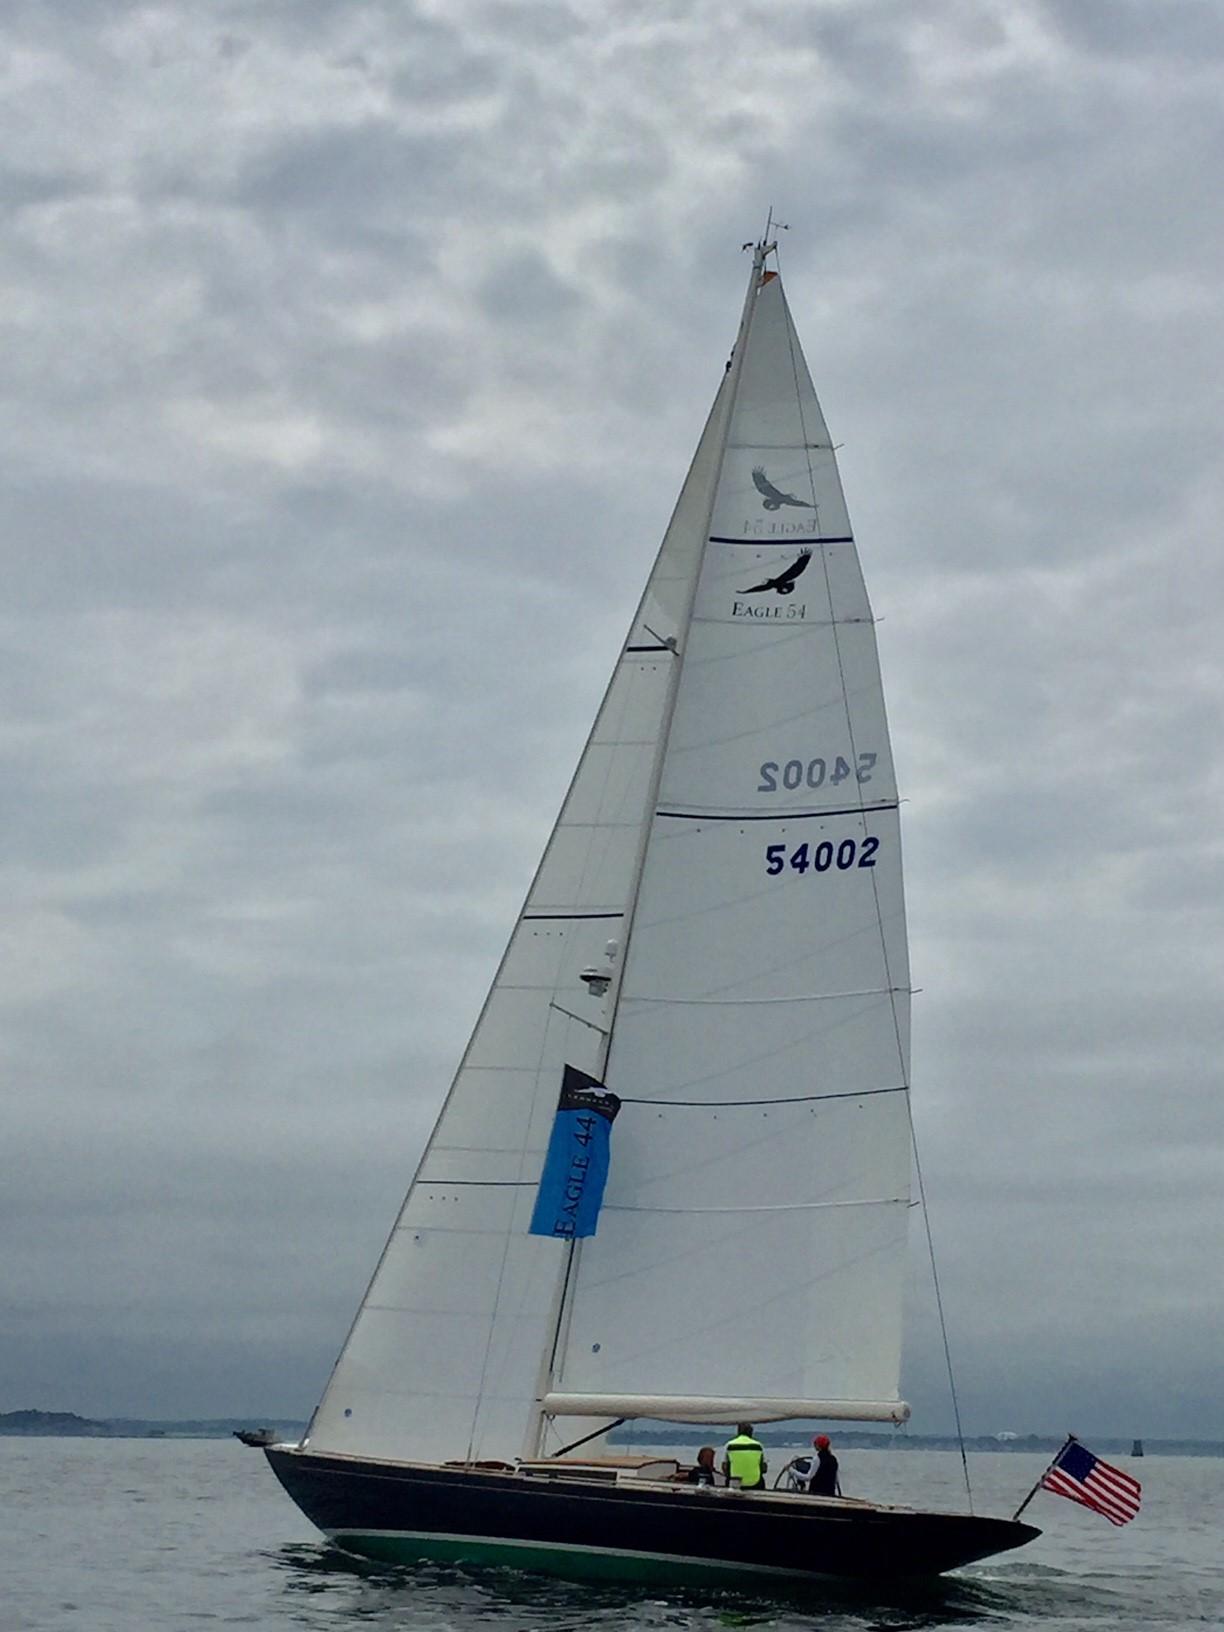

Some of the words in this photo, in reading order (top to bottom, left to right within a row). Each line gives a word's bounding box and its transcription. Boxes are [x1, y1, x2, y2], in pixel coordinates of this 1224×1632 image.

[732, 601, 783, 619] EAGLE
[786, 603, 806, 619] 54
[766, 837, 880, 875] 54002
[553, 1155, 590, 1237] EAGLE
[574, 1116, 597, 1148] 44
